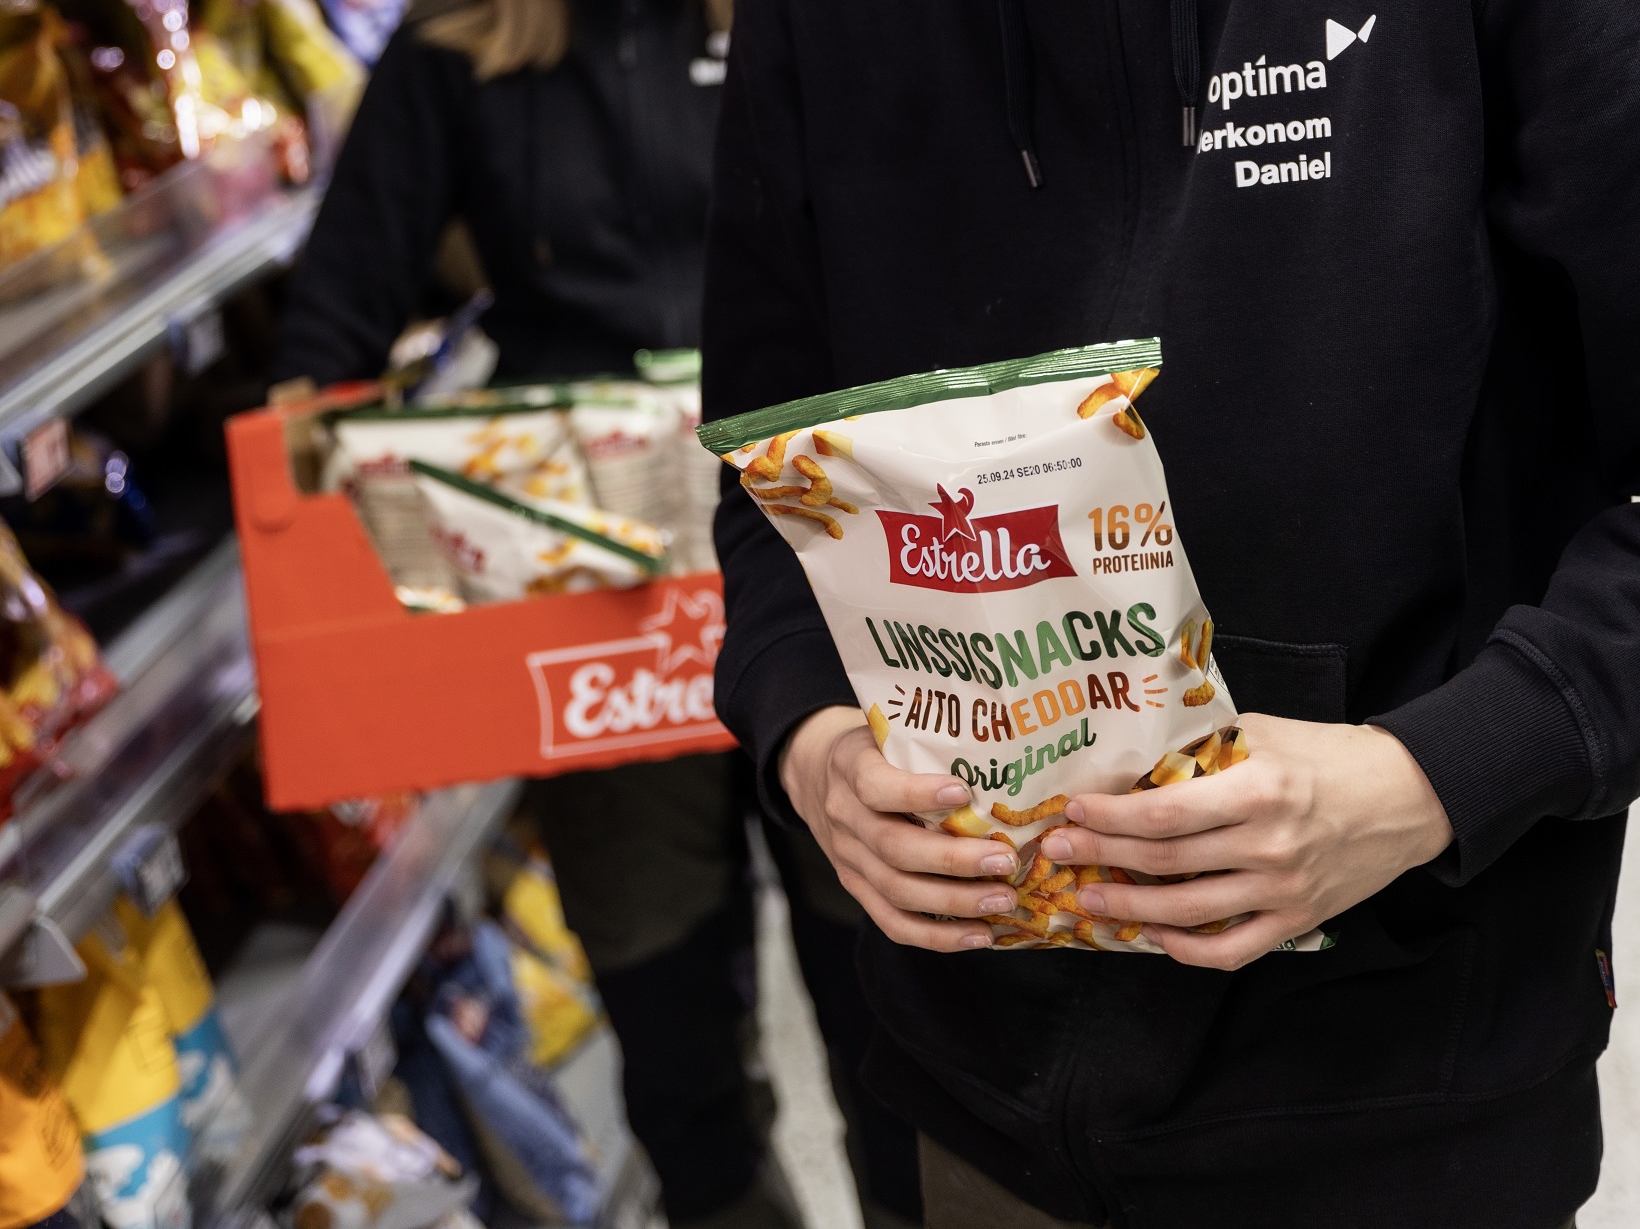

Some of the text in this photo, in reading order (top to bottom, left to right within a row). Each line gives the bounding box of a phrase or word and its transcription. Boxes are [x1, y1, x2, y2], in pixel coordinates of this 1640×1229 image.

[1208, 55, 1327, 110] optima
[1197, 117, 1332, 154] erkonom
[1235, 152, 1331, 188] Daniel
[977, 457, 1082, 484] 25.09.24 SE20 06:50:00
[1088, 501, 1173, 552] 16%
[901, 524, 1051, 583] Estrella
[1092, 551, 1174, 575] PROTEIINIA
[865, 602, 1166, 690] LINSSISNACKS
[905, 686, 961, 738] AITO
[972, 671, 1141, 742] CHEDDAR
[951, 717, 1097, 797] Original
